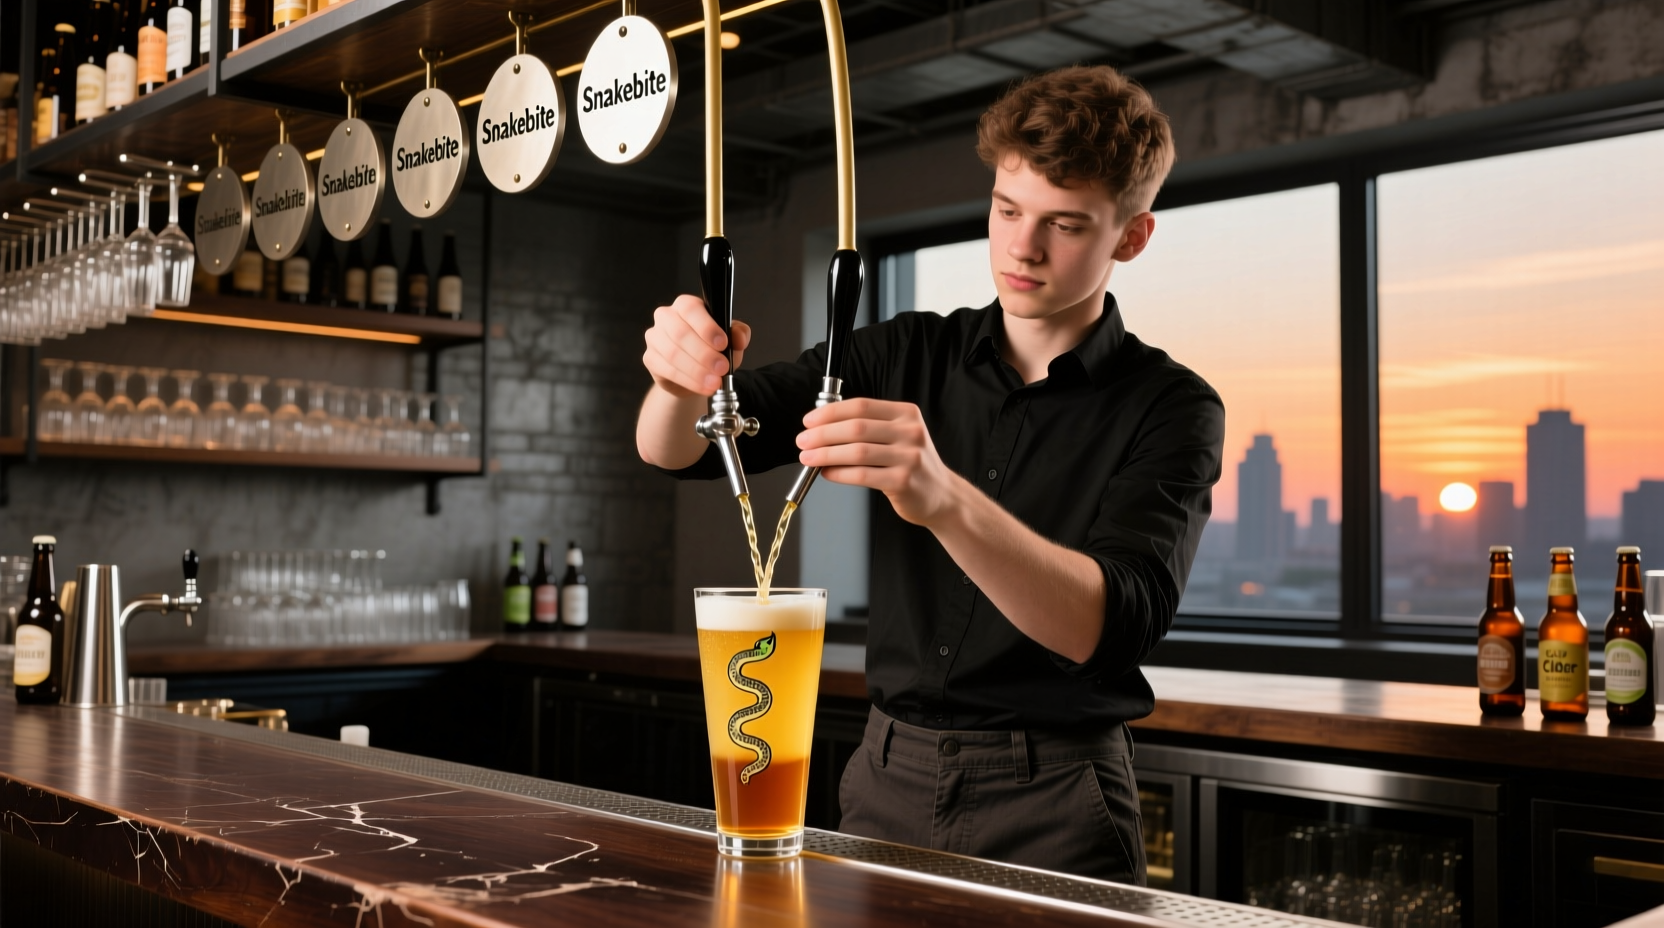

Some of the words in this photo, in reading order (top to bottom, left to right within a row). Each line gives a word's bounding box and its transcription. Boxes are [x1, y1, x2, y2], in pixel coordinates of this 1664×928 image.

[582, 69, 667, 113] Snakebite
[482, 105, 555, 145] Snakebite
[396, 135, 459, 172] Snakebite
[321, 164, 376, 196] Snakebite
